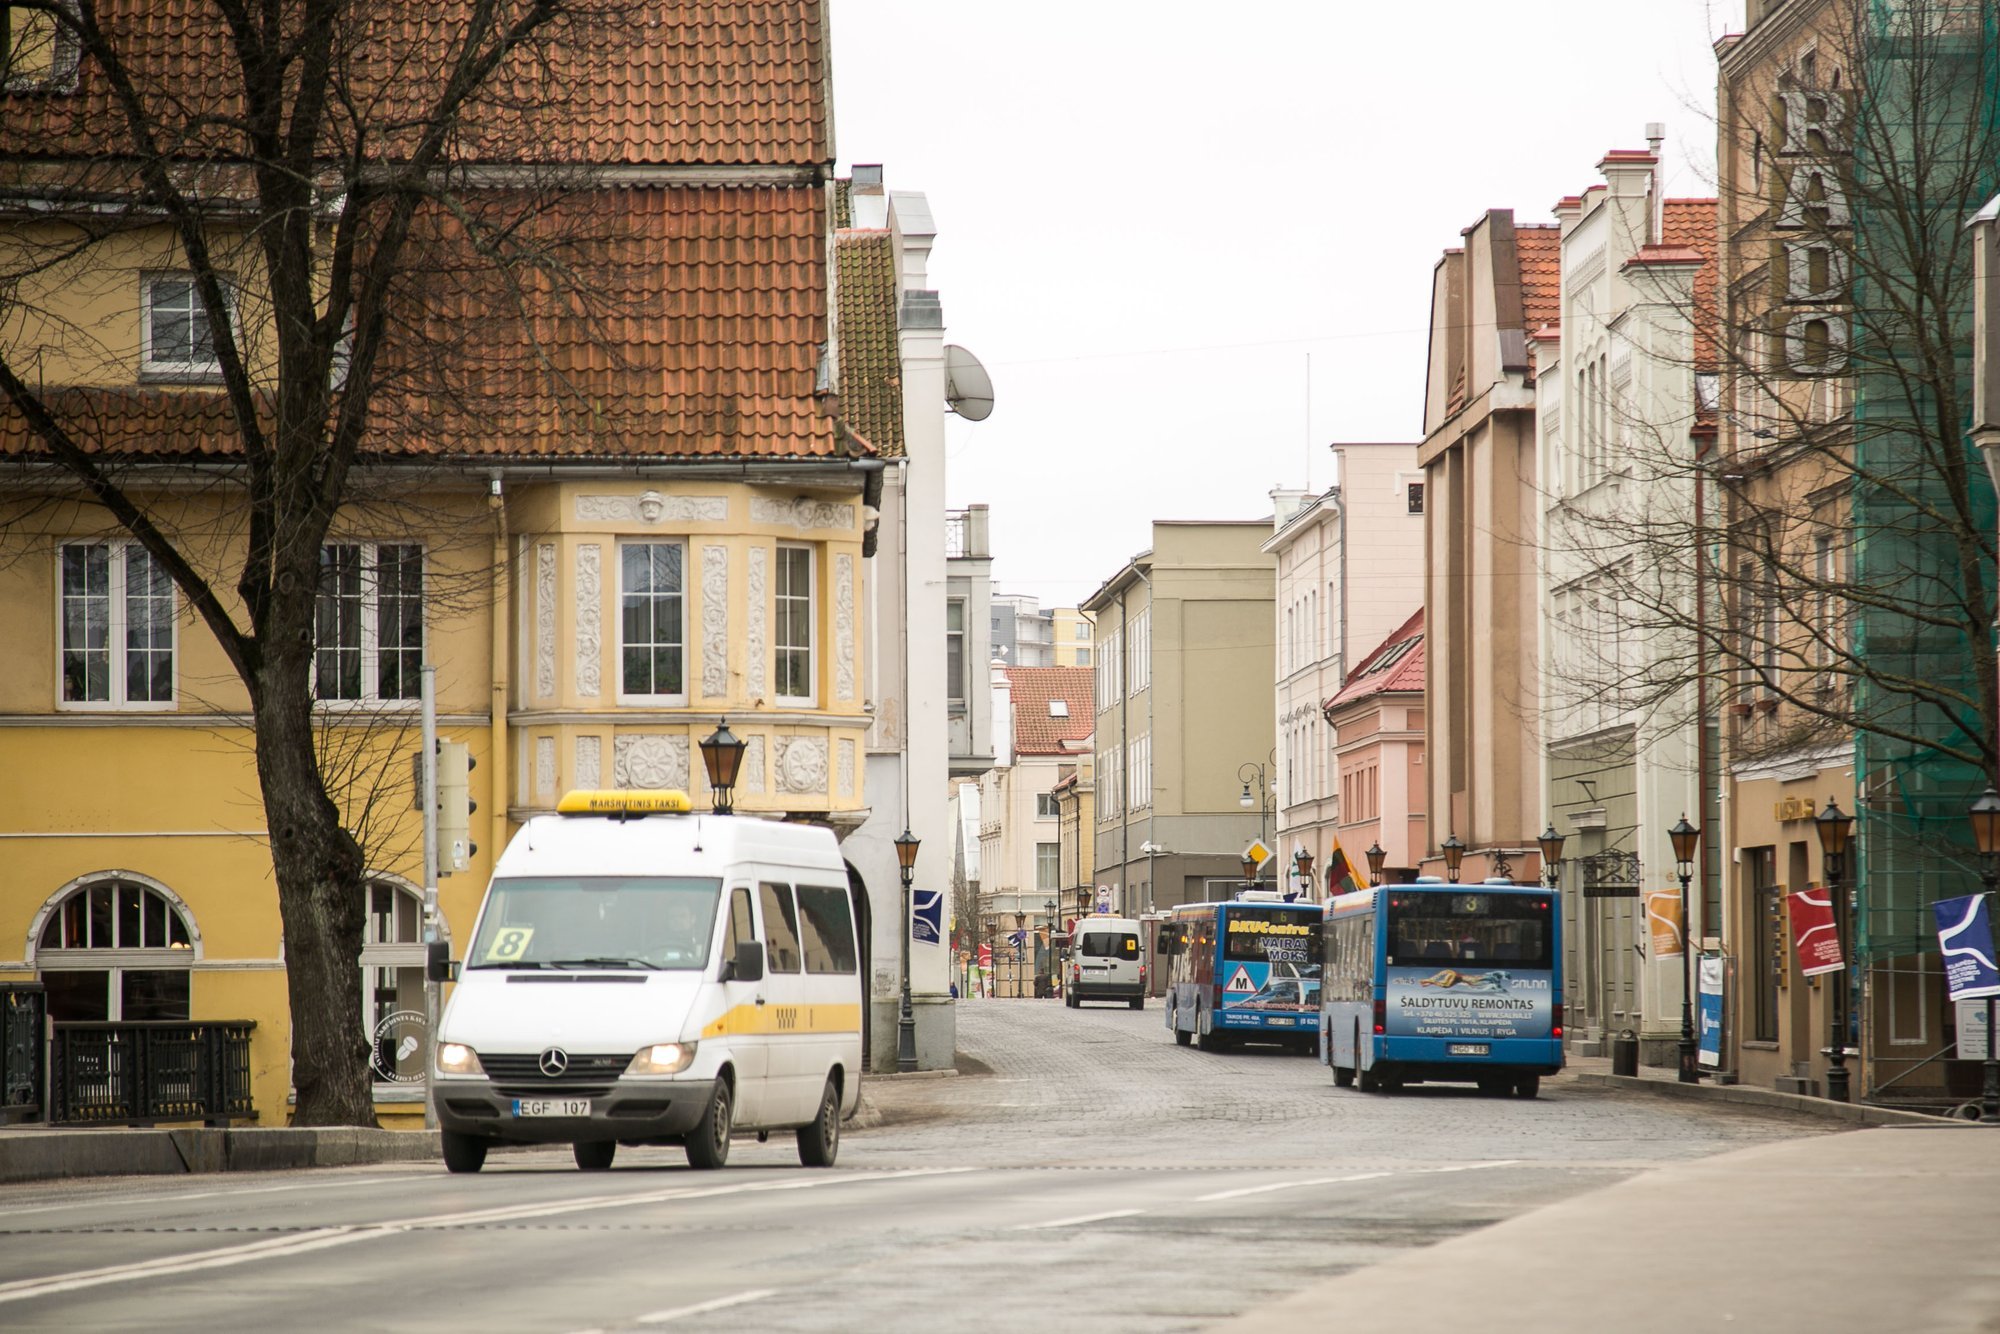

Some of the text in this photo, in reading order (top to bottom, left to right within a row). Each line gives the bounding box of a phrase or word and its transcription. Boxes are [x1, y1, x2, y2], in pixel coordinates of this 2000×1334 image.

[654, 799, 680, 809] TAKSI
[1466, 896, 1477, 912] 3
[496, 931, 525, 957] 8
[1235, 977, 1248, 989] M
[1400, 996, 1534, 1011] ŠALDYTUVŲ REMONTAS
[1417, 1025, 1453, 1034] KLAIPĖDA
[1461, 1027, 1490, 1035] VILNIUS
[521, 1101, 587, 1115] EGF 107
